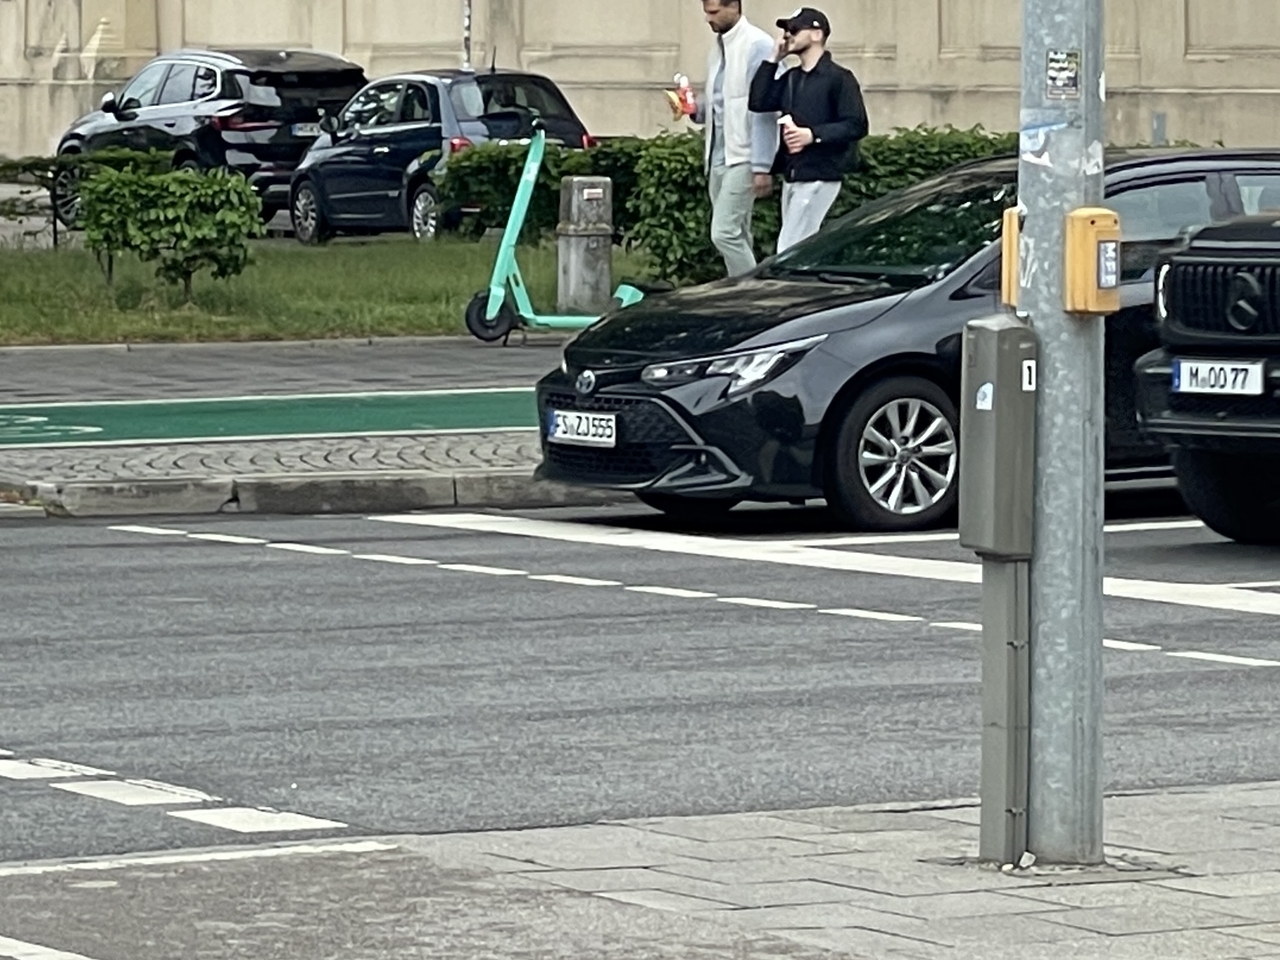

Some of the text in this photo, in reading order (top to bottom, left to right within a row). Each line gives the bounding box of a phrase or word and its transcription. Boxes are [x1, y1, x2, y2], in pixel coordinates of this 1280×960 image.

[1026, 365, 1033, 386] 1
[1230, 367, 1249, 390] 77
[591, 416, 614, 439] 555
